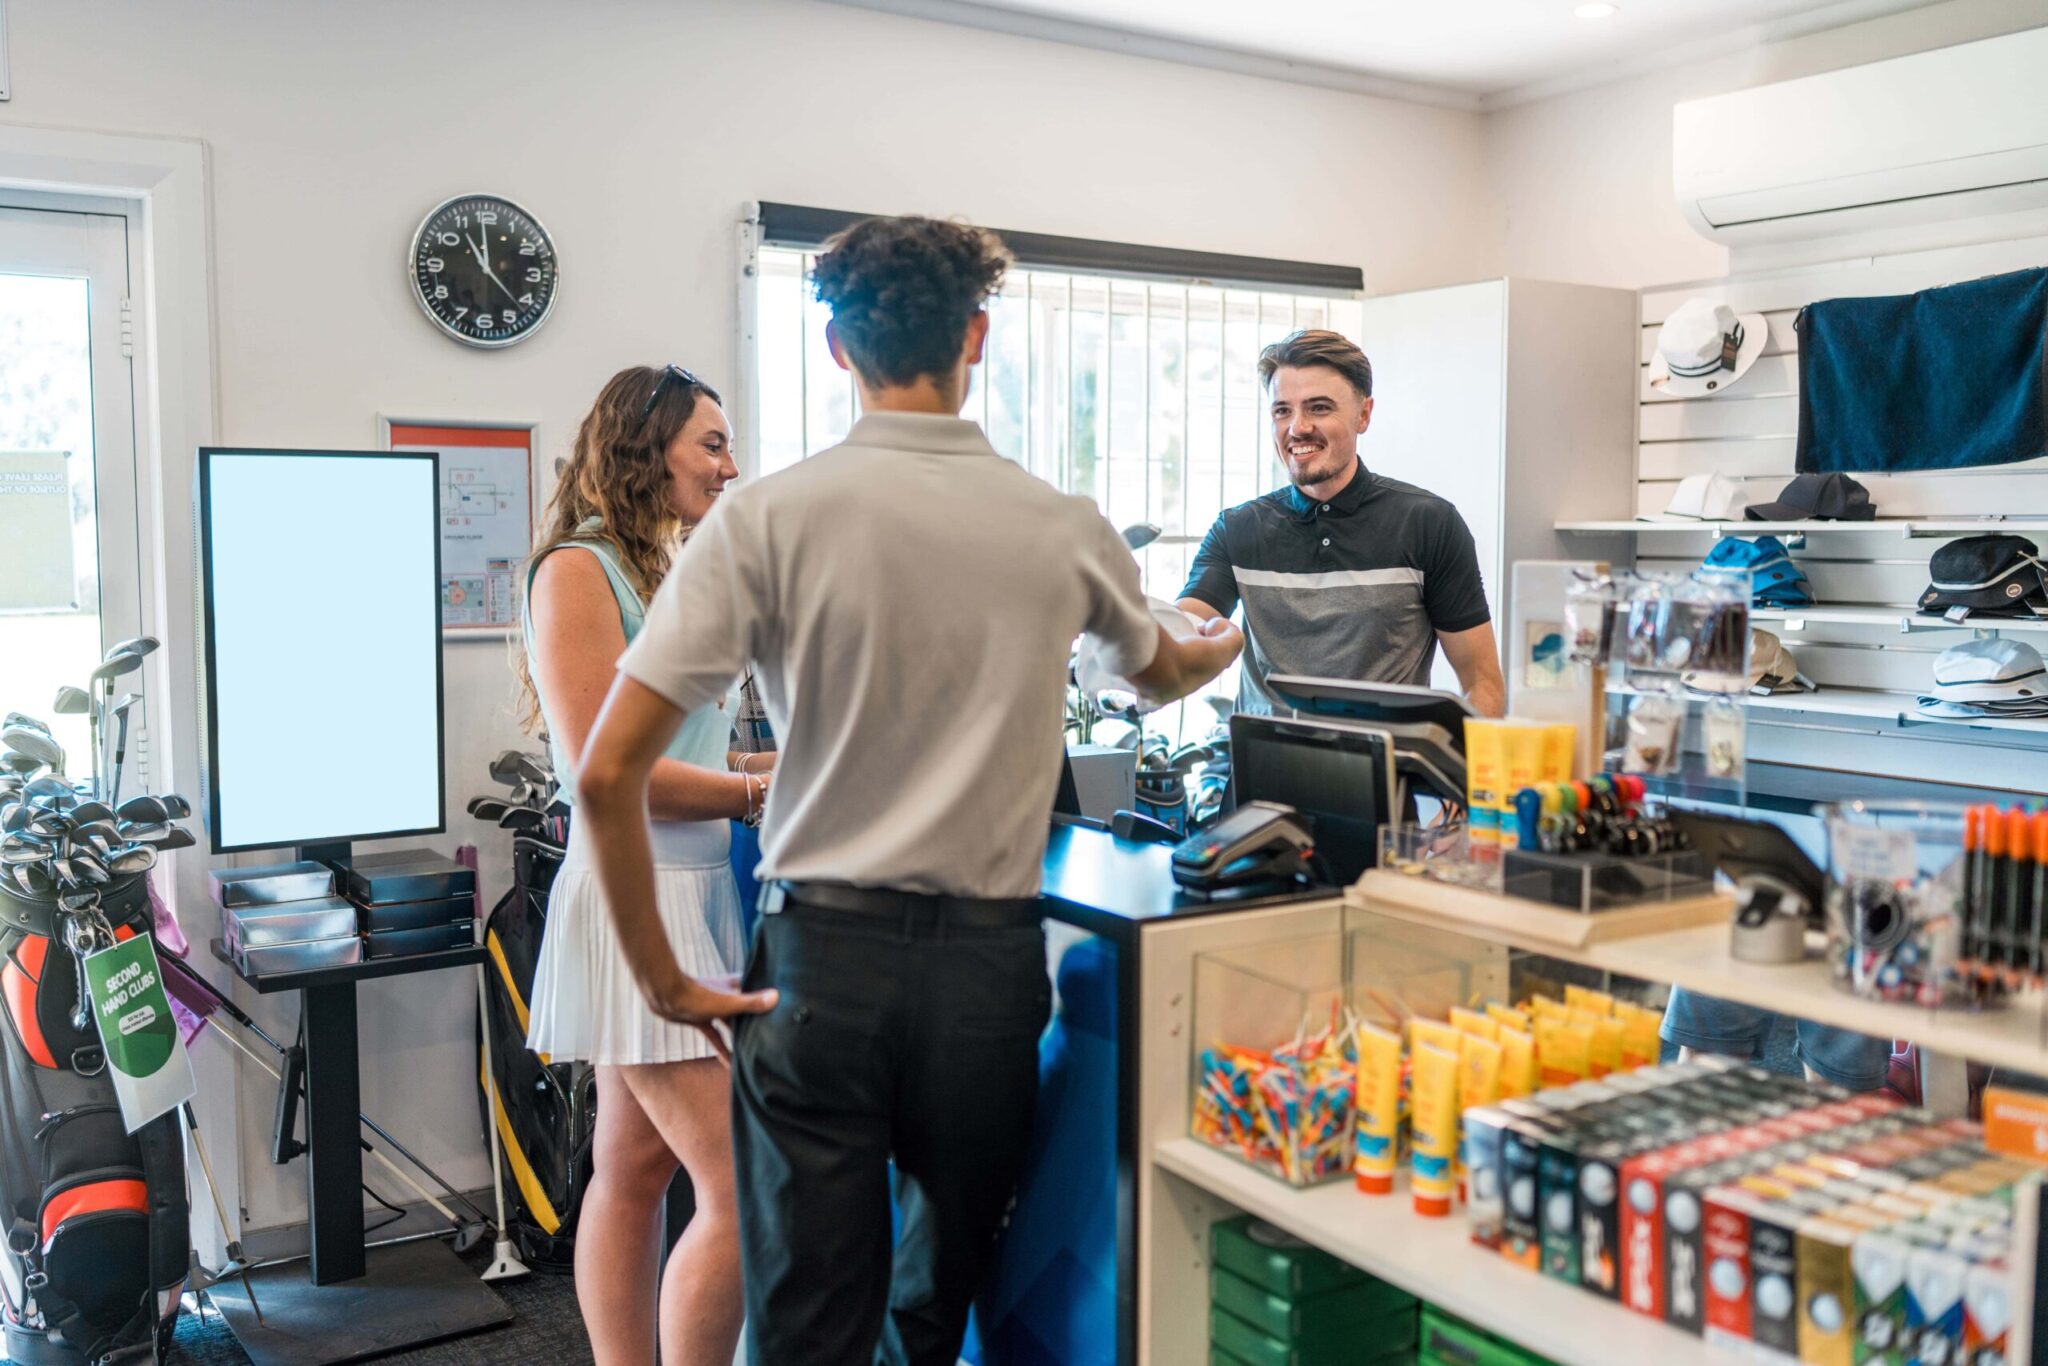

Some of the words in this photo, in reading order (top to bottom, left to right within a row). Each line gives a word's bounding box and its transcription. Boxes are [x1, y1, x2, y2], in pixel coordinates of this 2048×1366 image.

[454, 215, 468, 228] 11
[474, 210, 497, 225] 12
[508, 220, 515, 233] 1
[436, 232, 460, 246] 10
[519, 242, 536, 256] 2
[426, 258, 444, 273] 9
[526, 268, 541, 283] 3
[434, 285, 448, 299] 8
[519, 292, 534, 306] 4
[455, 307, 468, 320] 7
[502, 310, 516, 324] 5
[476, 314, 494, 328] 6
[106, 962, 141, 994] SECOND
[102, 990, 128, 1017] HAND
[128, 971, 155, 998] CLUBS
